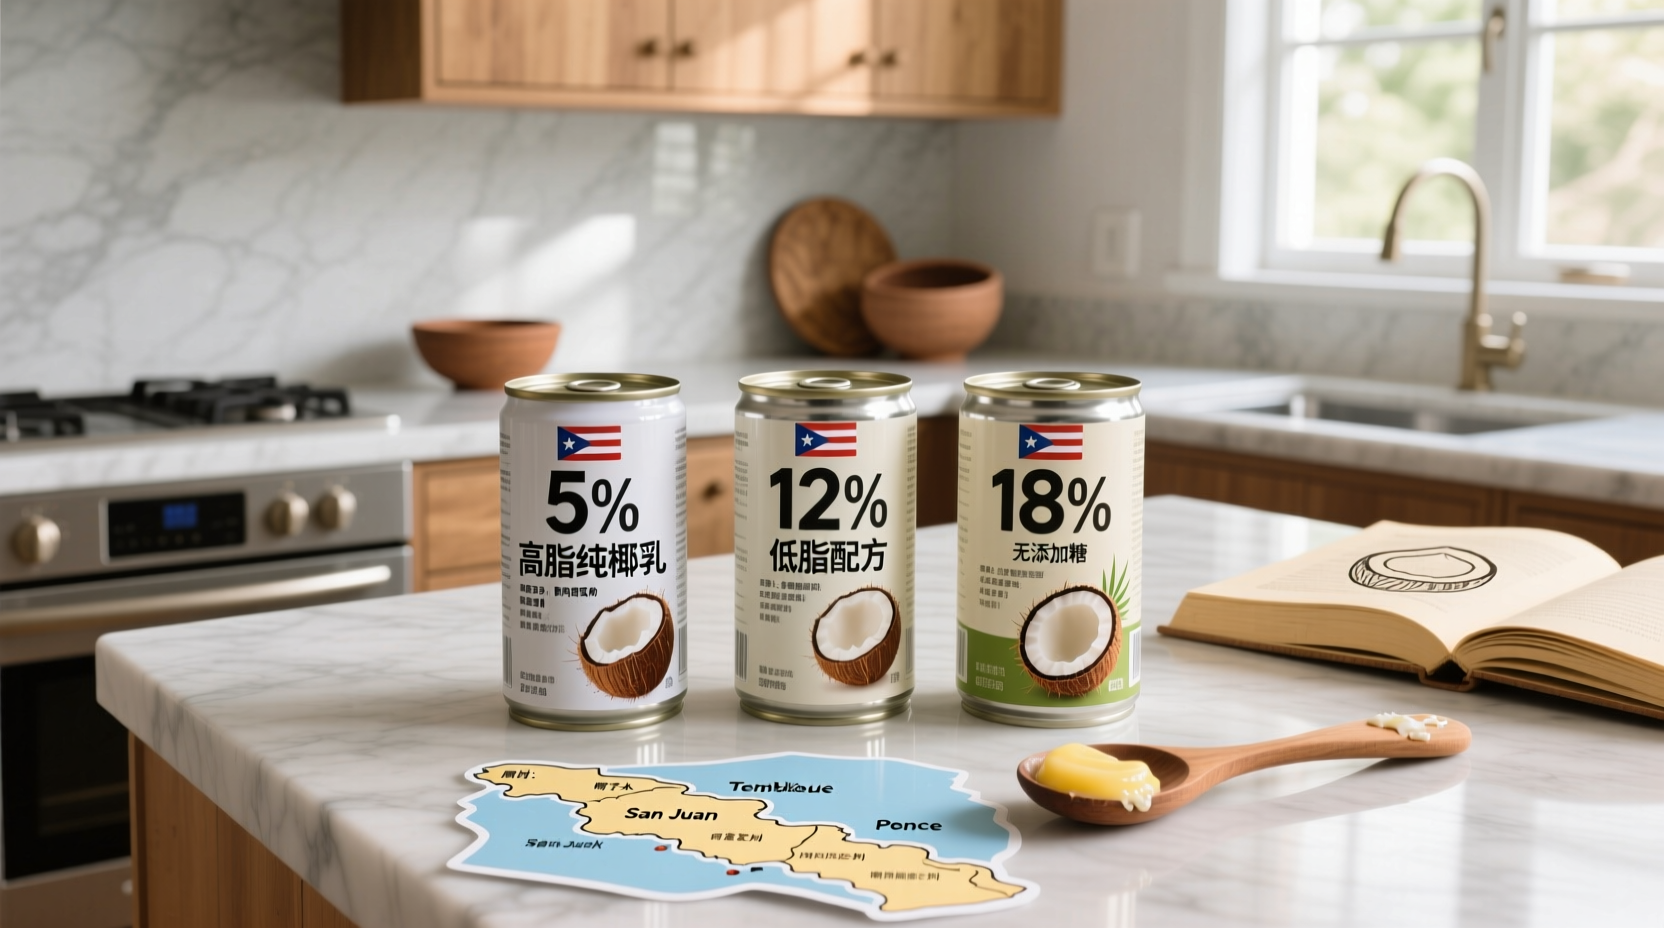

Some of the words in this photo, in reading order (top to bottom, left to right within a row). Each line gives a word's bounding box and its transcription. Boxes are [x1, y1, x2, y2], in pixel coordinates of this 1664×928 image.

[546, 470, 639, 535] 5%
[770, 467, 888, 531] 12%
[992, 468, 1112, 535] 18%
[519, 540, 667, 579] 高脂纯椰乳
[769, 538, 888, 575] 低脂配方
[1012, 542, 1088, 564] 无添加糖
[624, 807, 664, 820] San
[668, 808, 718, 821] Juan
[875, 819, 943, 832] Ponce
